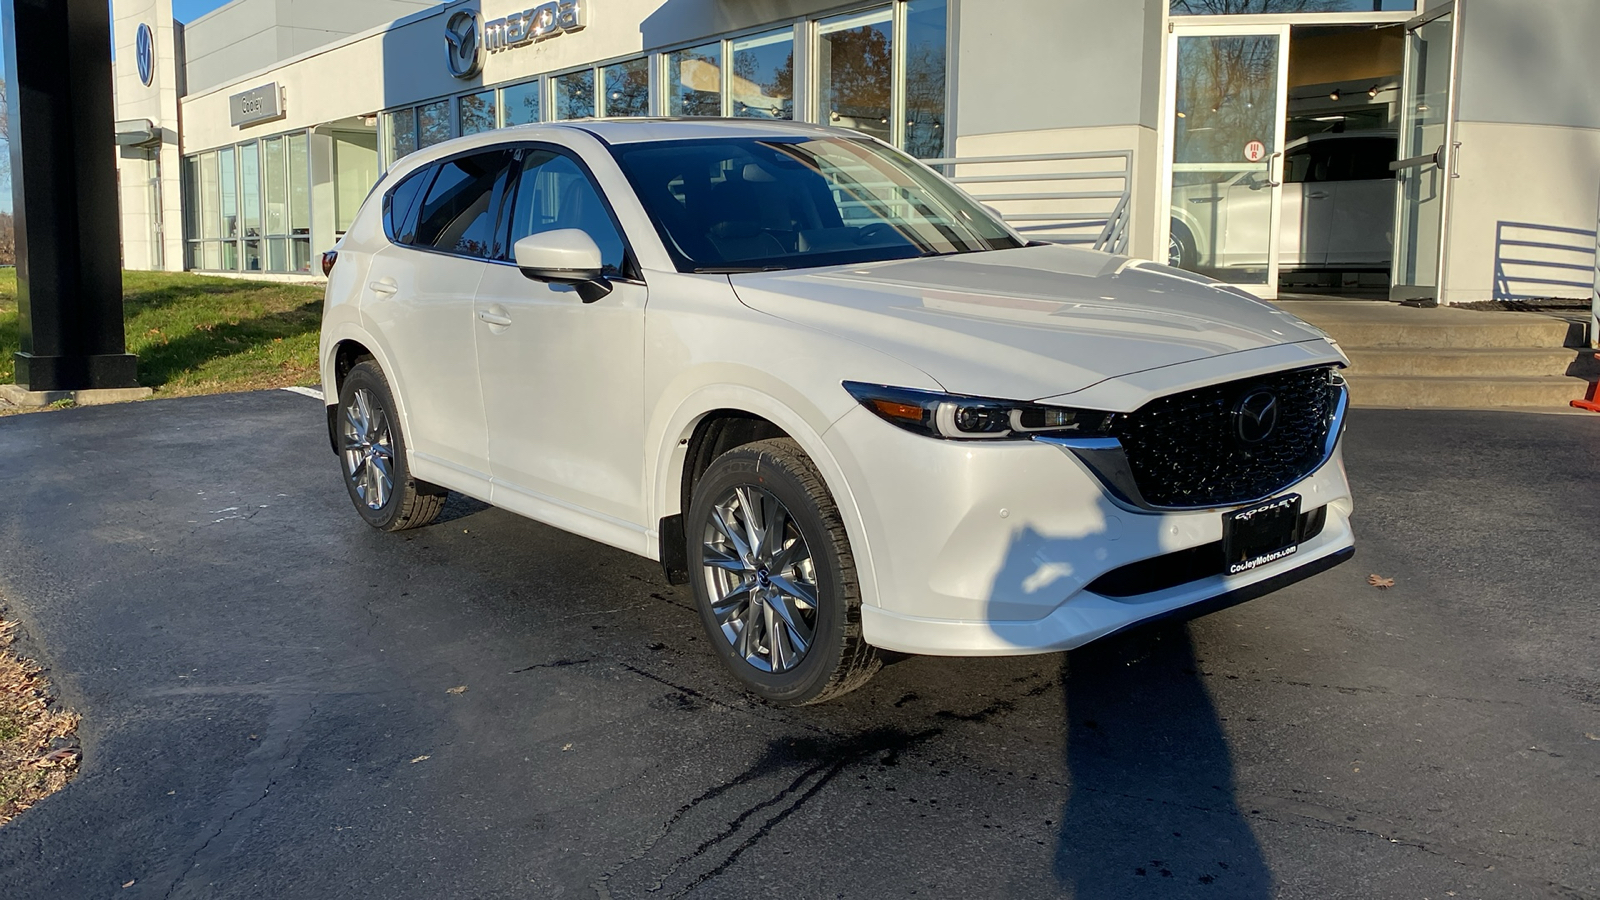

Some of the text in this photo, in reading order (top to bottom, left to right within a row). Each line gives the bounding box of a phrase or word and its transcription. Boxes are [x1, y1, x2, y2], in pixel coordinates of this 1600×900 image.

[484, 0, 583, 52] mazda
[242, 92, 263, 115] Cooley
[1235, 496, 1299, 519] COOLEY
[1230, 545, 1296, 573] CooleyMotors.com
